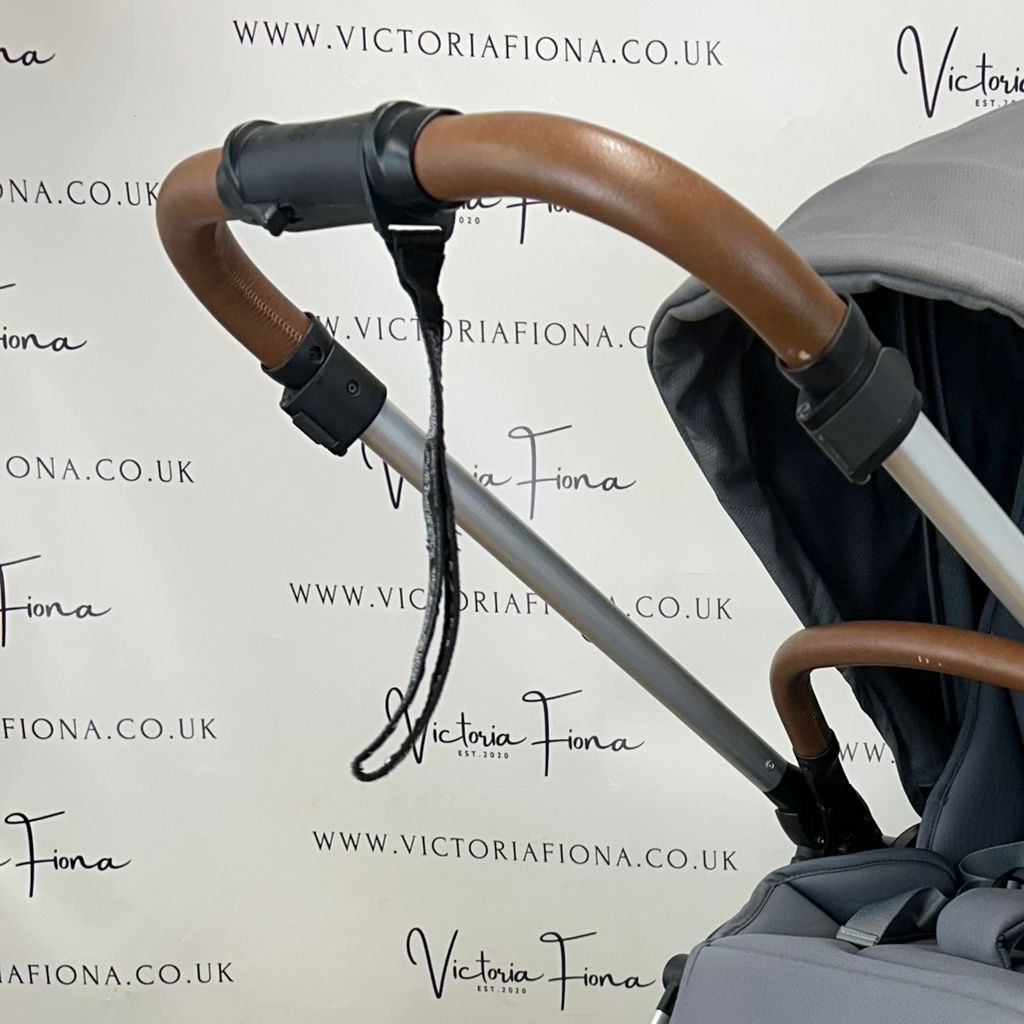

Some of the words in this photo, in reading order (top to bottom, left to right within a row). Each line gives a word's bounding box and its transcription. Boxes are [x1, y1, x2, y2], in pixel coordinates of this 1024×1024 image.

[233, 20, 724, 66] WWW.VICTORIAFIONA.CO.UK
[508, 424, 638, 520] Fiona
[457, 749, 510, 759] EST.2020
[521, 689, 645, 777] Fiona
[4, 810, 132, 898] Fiona
[312, 831, 739, 871] WWW.VICTORIAFIONA.CO.UK
[405, 927, 545, 1000] Victoria
[539, 930, 657, 1012] Fiona
[476, 985, 528, 995] EST.2020
